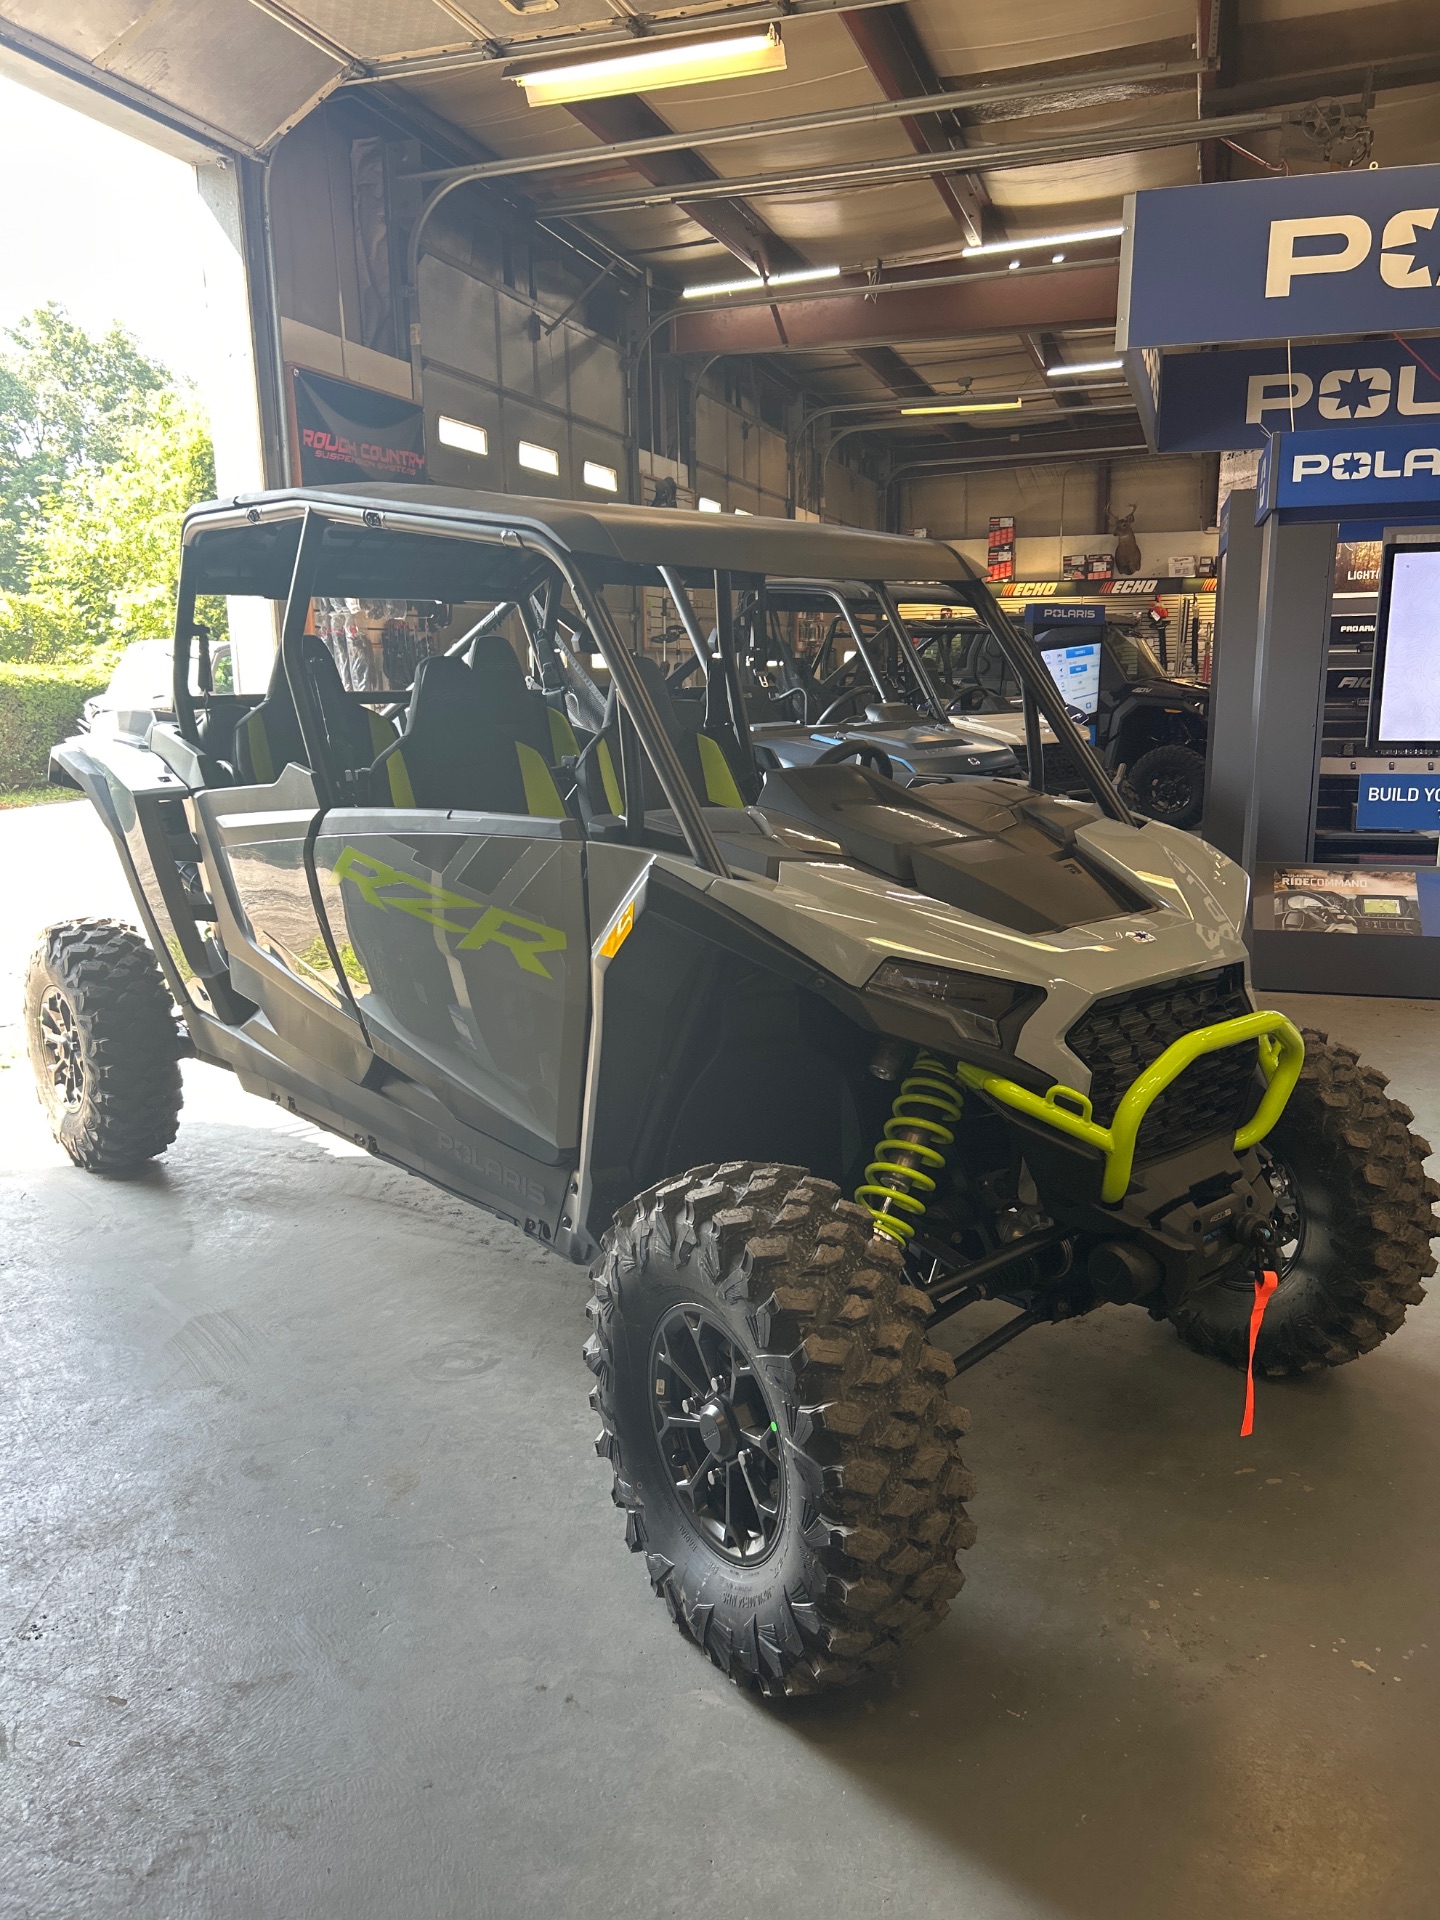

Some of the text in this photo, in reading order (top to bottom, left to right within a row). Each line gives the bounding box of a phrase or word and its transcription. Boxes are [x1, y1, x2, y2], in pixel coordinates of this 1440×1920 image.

[1265, 208, 1440, 298] PO
[303, 429, 425, 469] ROUGH COUNTRY
[1347, 570, 1380, 580] LIGHTI
[1012, 582, 1058, 596] ECHO
[1110, 580, 1158, 594] ECHO
[1043, 608, 1096, 619] POLARIS
[1368, 787, 1420, 802] BUILD
[328, 845, 568, 980] RZR
[439, 1132, 547, 1206] POLARIS
